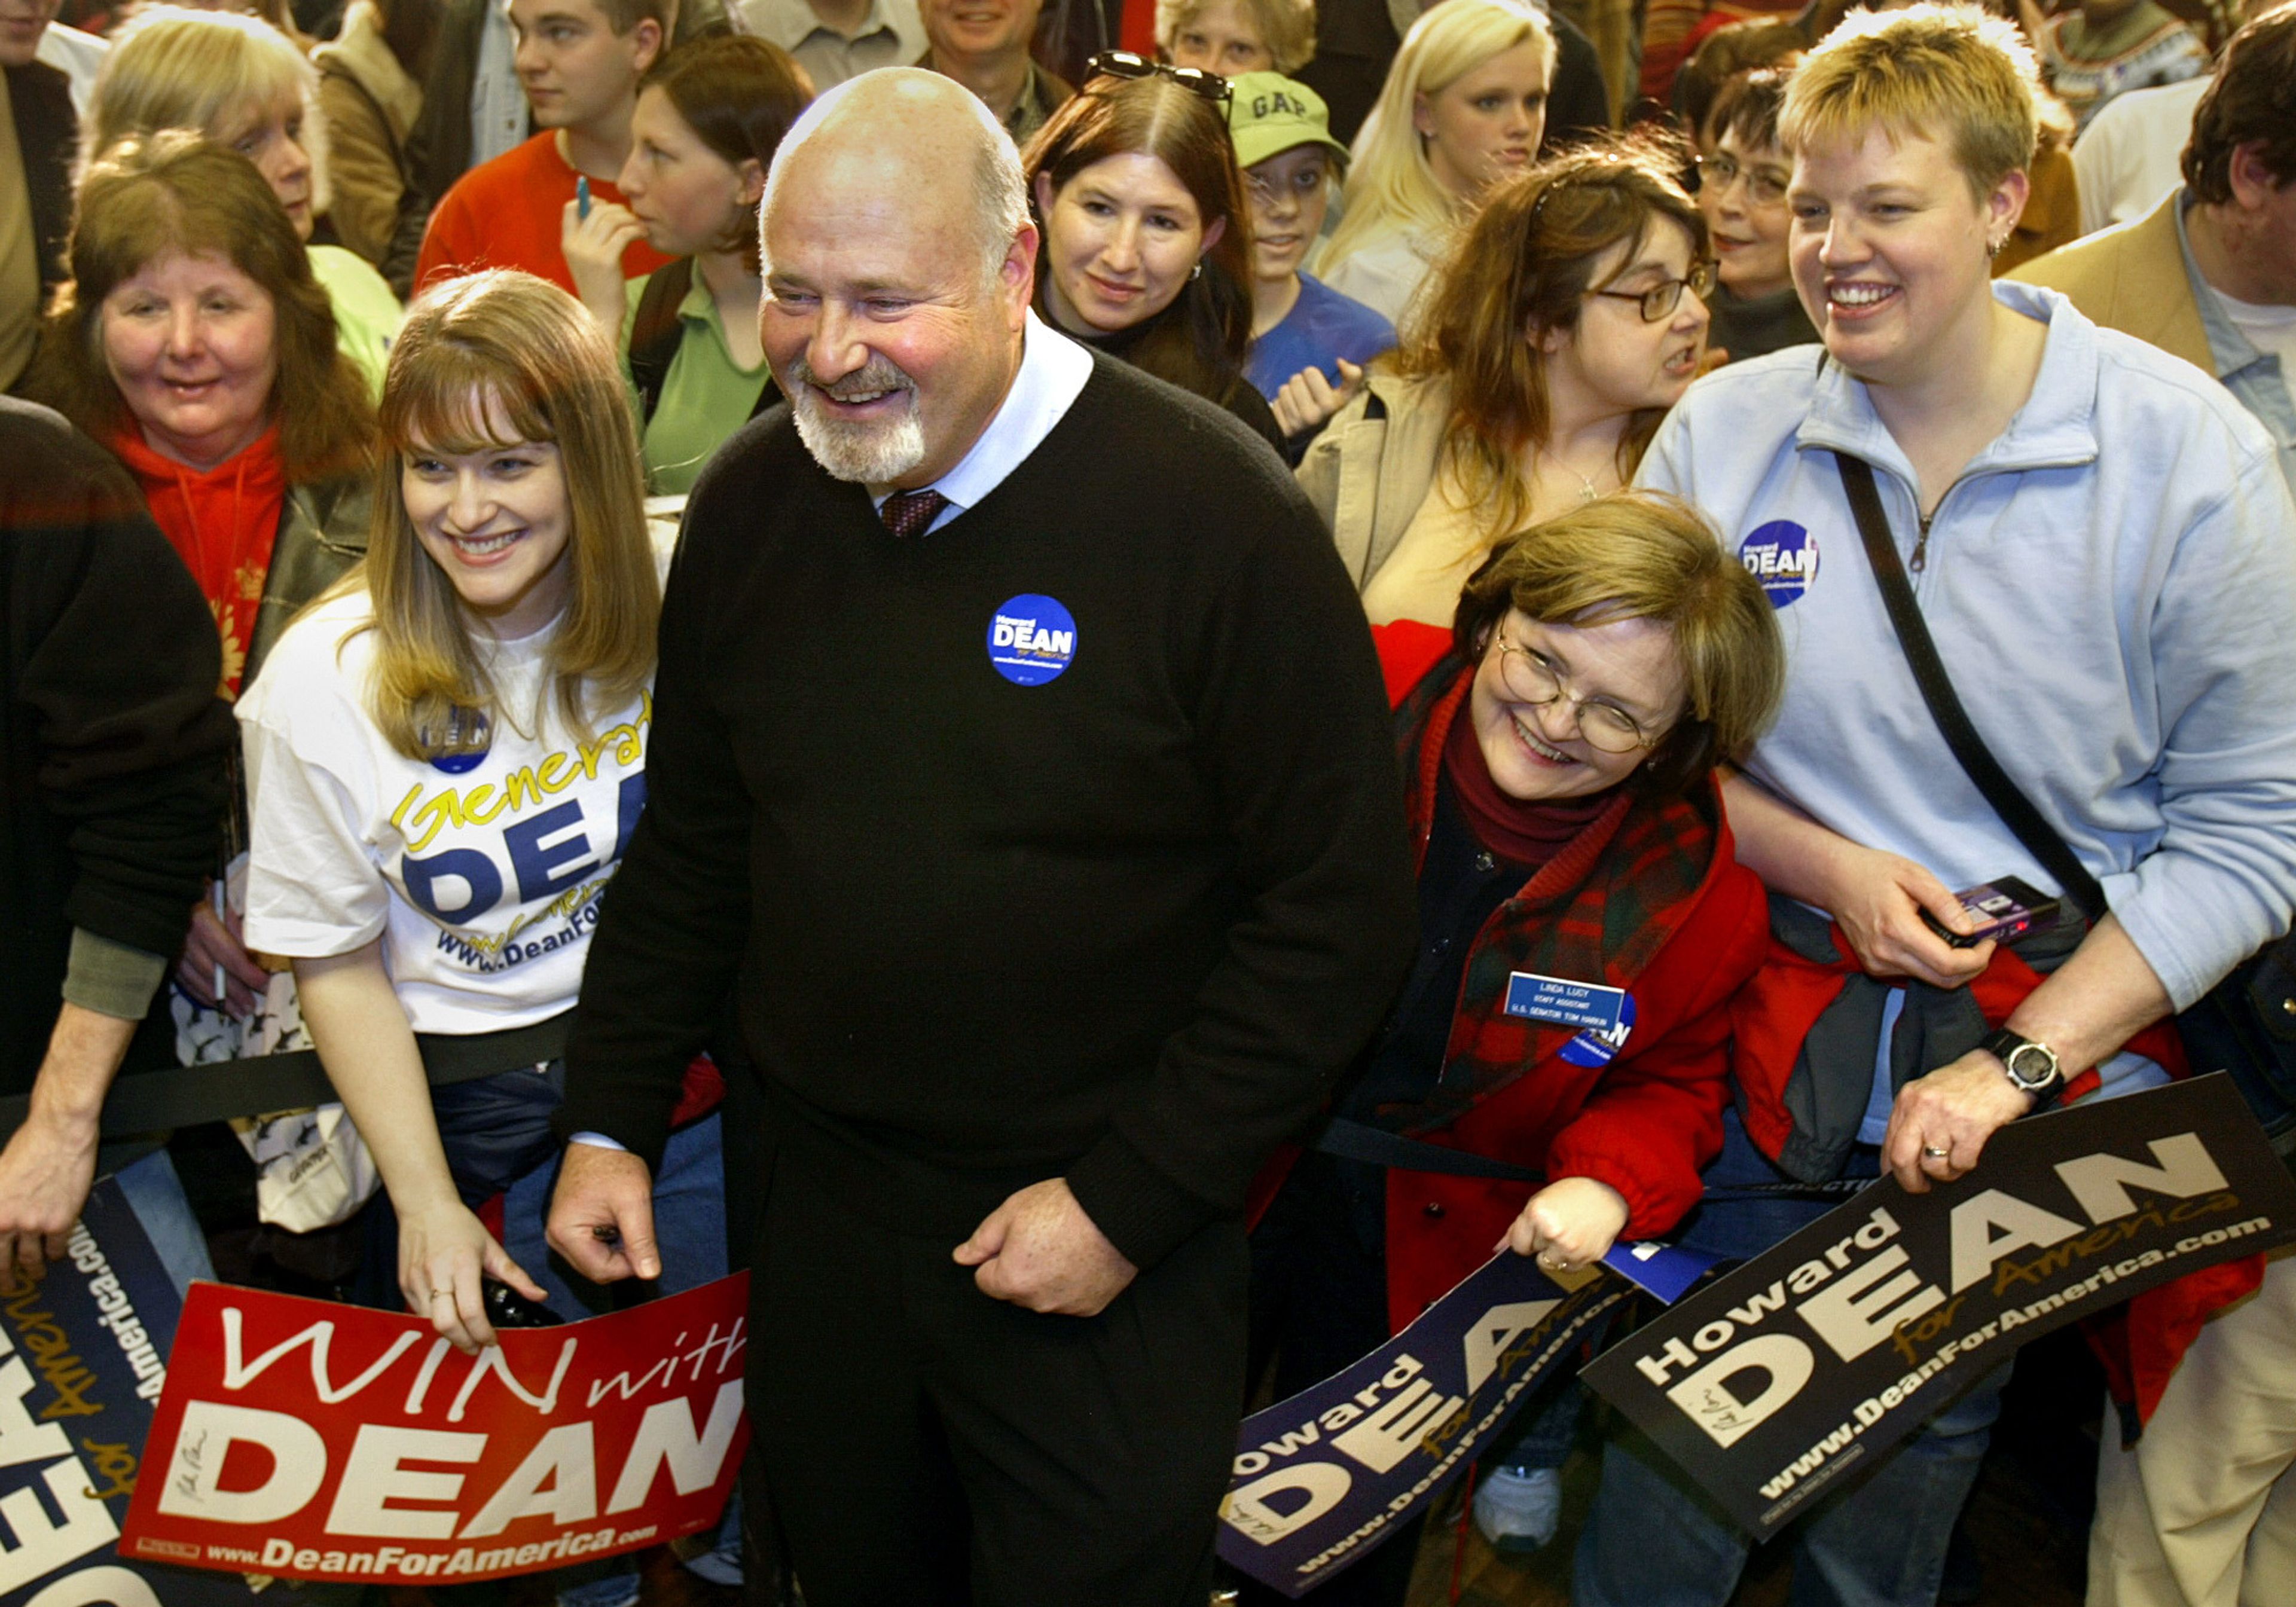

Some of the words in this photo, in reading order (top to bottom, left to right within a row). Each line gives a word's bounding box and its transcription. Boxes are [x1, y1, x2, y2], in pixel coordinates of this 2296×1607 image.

[1253, 91, 1306, 118] GAP
[1743, 549, 1818, 575] DEAN
[993, 624, 1073, 654] DEAN
[1635, 1206, 1902, 1387] Howard
[1666, 1131, 2230, 1450] DEAN
[1891, 1294, 1966, 1367] for
[1992, 1191, 2242, 1297] America
[222, 1307, 578, 1422] WIN
[1232, 1353, 1424, 1478] oward
[1758, 1215, 2272, 1501] www.DeanForAmerica.com
[157, 1377, 745, 1540] DEAN
[207, 1524, 658, 1575] www.DeanForAmerica.com
